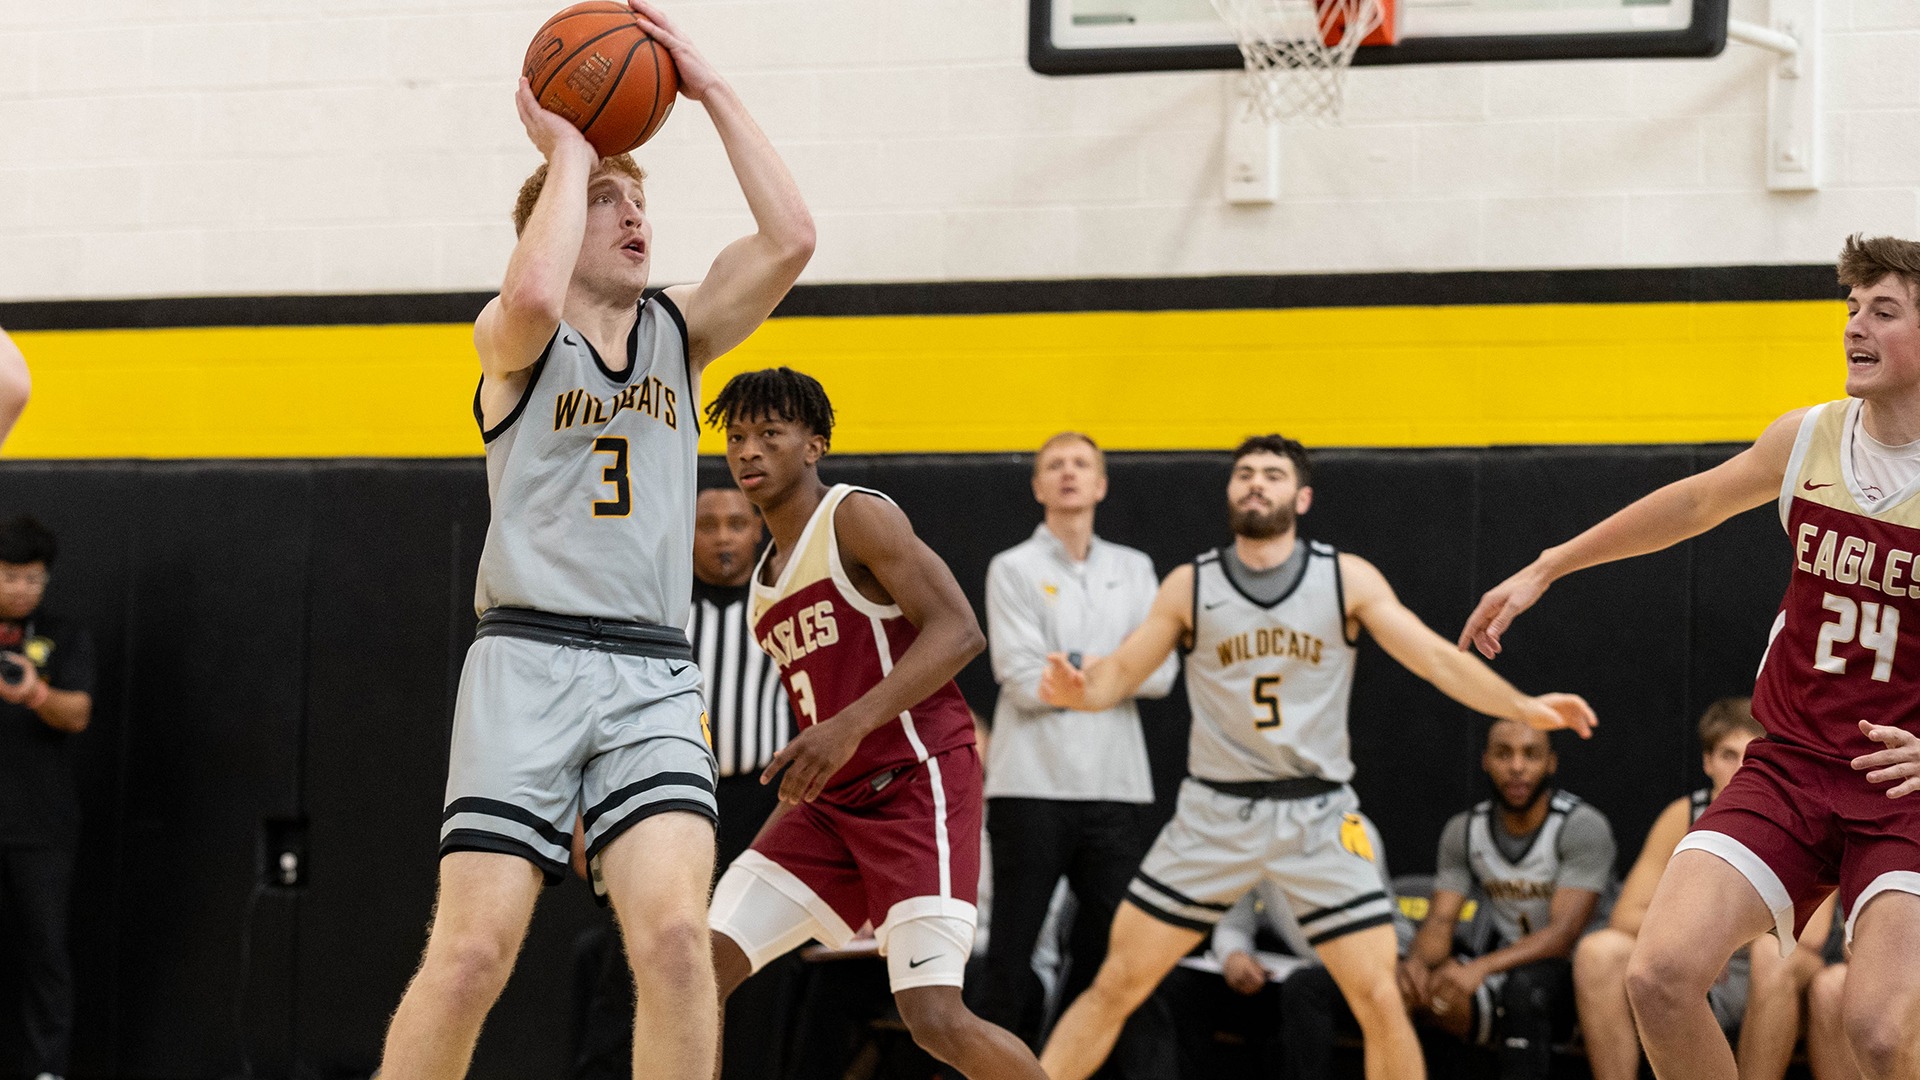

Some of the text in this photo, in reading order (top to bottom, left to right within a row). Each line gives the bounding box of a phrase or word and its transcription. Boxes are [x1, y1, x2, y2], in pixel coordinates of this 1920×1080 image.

[591, 435, 633, 519] 3
[1216, 626, 1324, 668] WILDCATS
[1813, 591, 1900, 683] 24
[1252, 673, 1283, 732] 5
